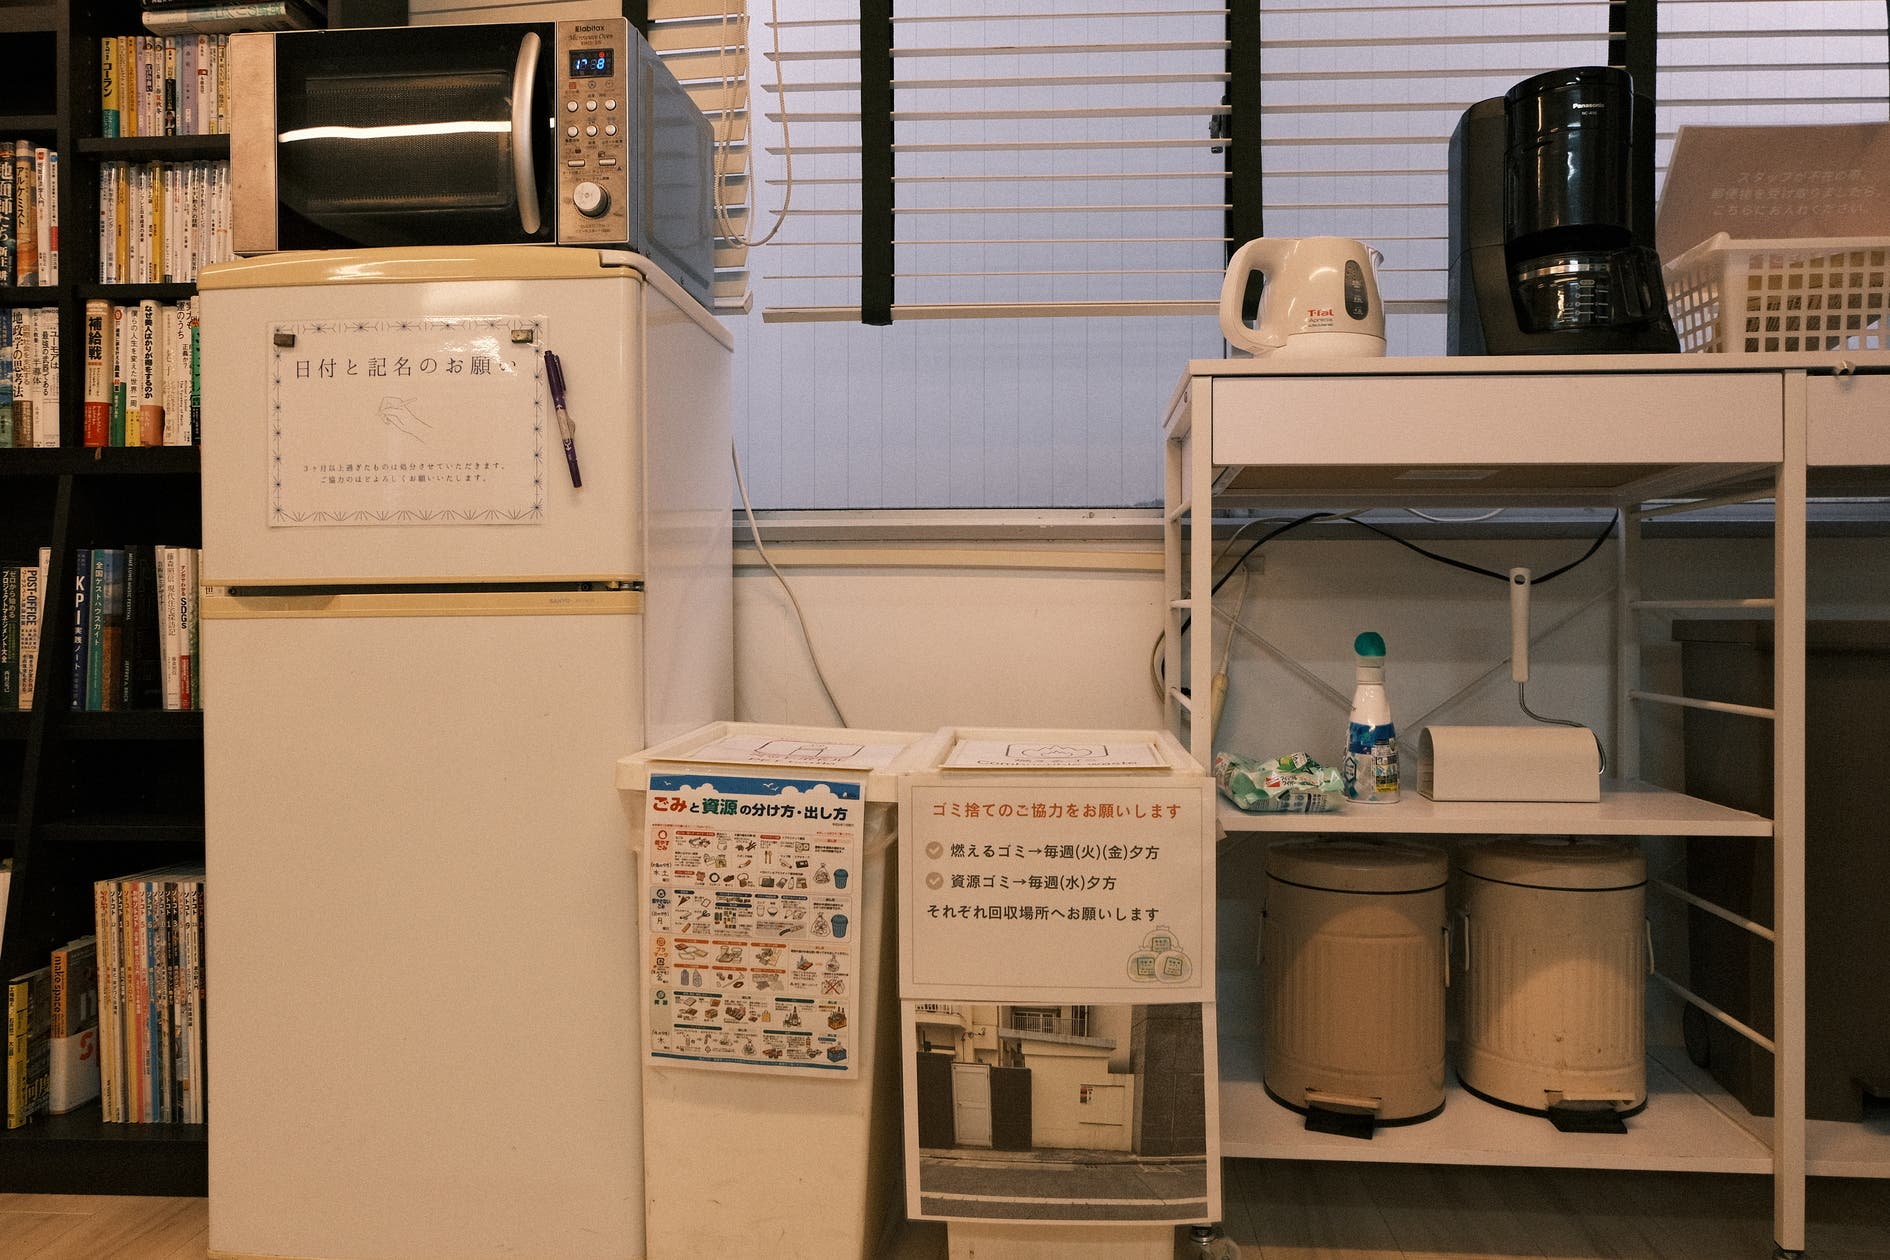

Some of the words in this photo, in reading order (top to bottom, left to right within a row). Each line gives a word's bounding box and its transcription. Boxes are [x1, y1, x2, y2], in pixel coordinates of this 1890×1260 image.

[103, 63, 112, 97] コーラン
[17, 167, 25, 229] アルケミスト
[88, 317, 102, 360] 補給戦
[12, 311, 23, 398] 地政学の思考法
[296, 356, 516, 379] 日付と記名のお願い
[653, 796, 848, 820] ごみと資源の分け方・出し方
[933, 803, 1181, 819] ゴミ捨てのご協力をお願いします
[950, 844, 1025, 859] 燃えるゴミ
[950, 874, 1010, 890] 資源ゴミ
[927, 905, 1160, 921] それぞれ回収場所へお願いします
